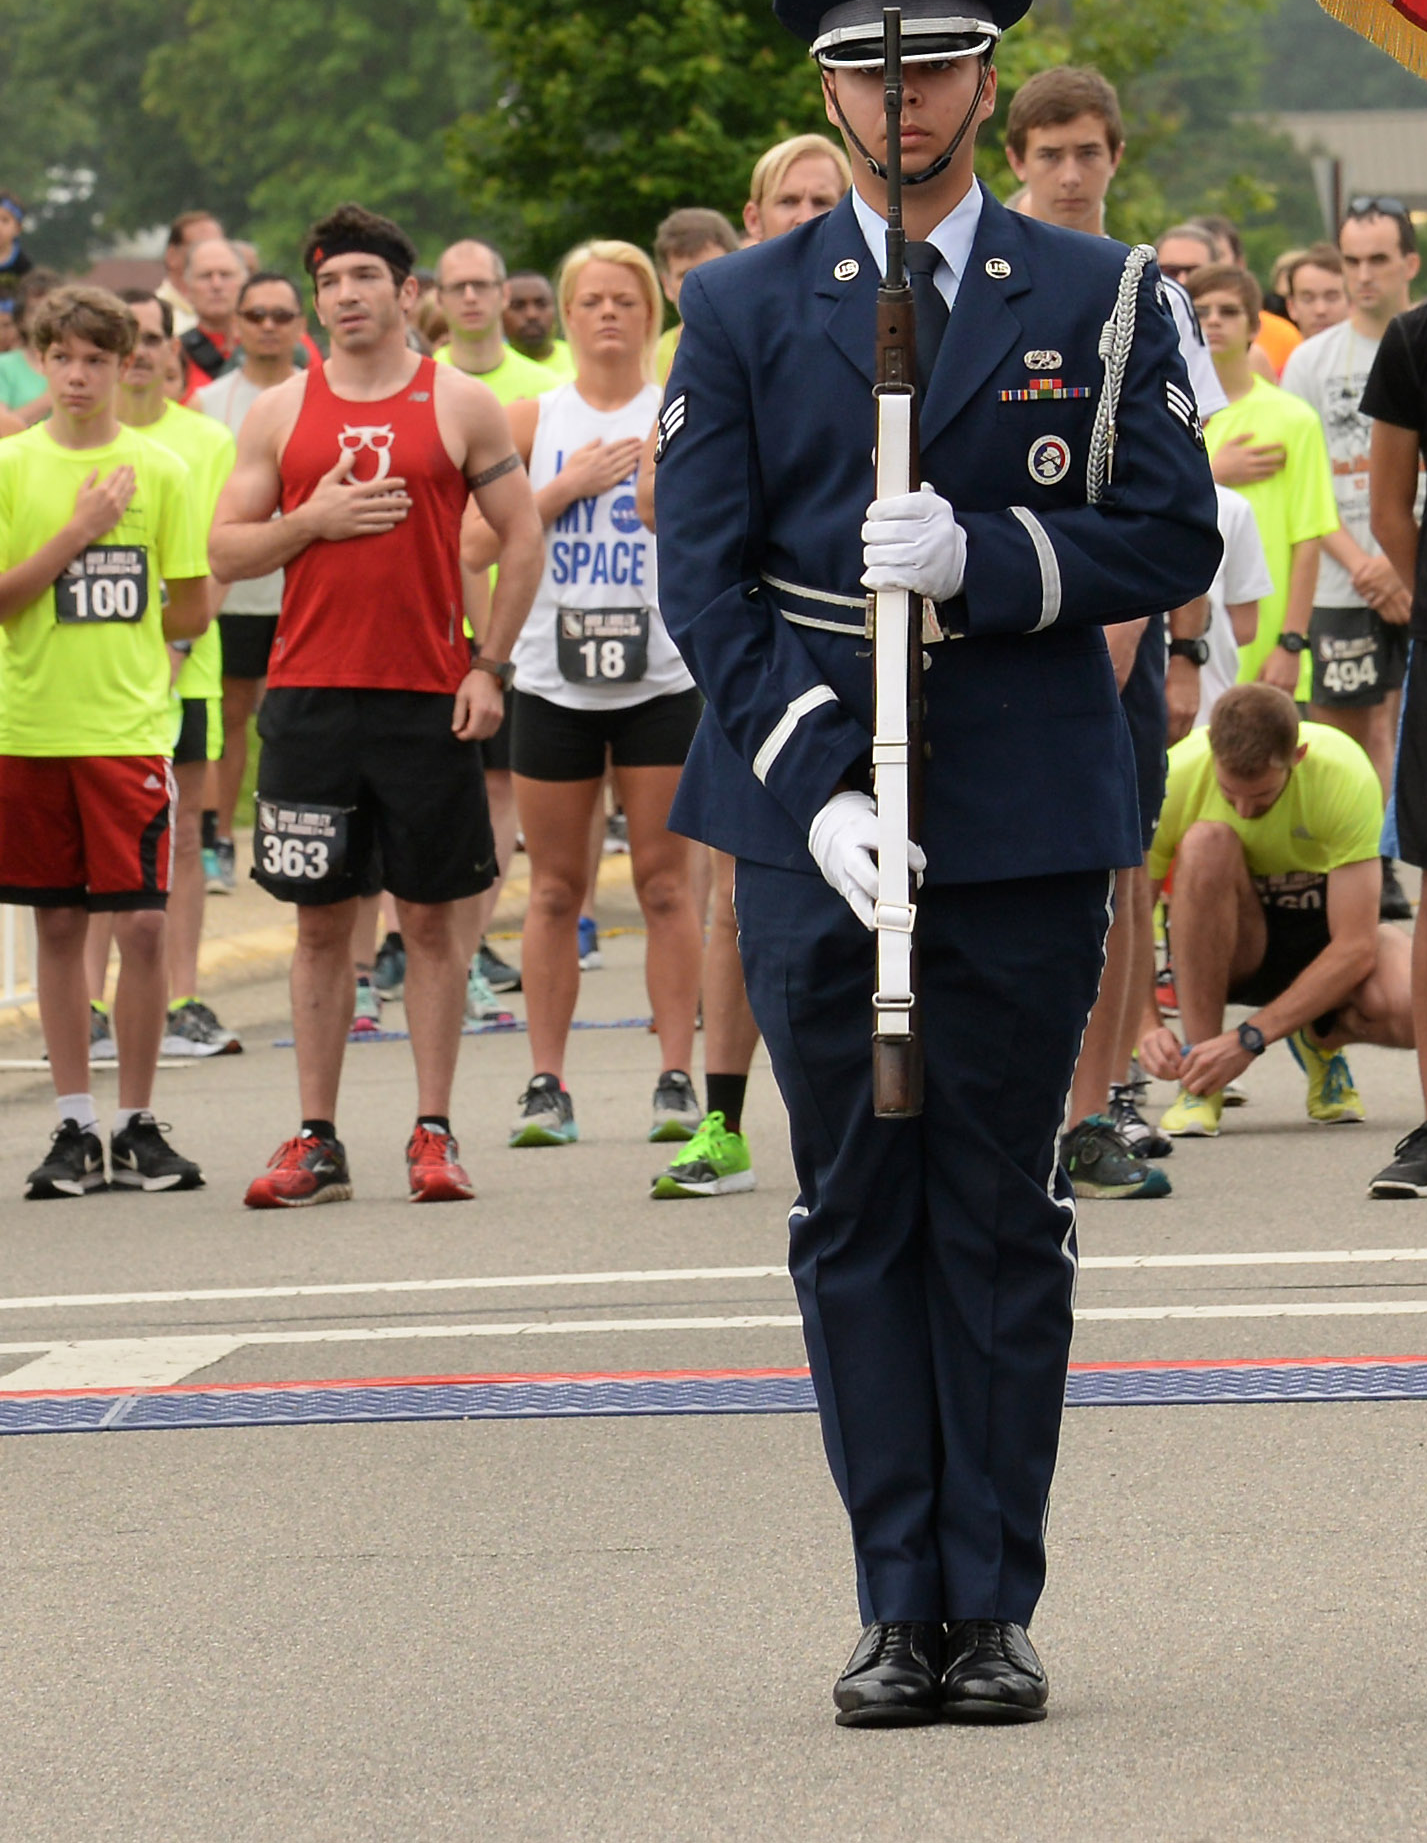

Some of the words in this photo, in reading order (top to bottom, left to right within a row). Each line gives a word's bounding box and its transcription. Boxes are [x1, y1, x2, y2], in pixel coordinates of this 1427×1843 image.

[989, 260, 1009, 274] US
[552, 541, 646, 586] SPACE
[69, 578, 138, 618] 100
[579, 640, 626, 679] 18
[1323, 655, 1378, 693] 494
[262, 834, 329, 880] 363
